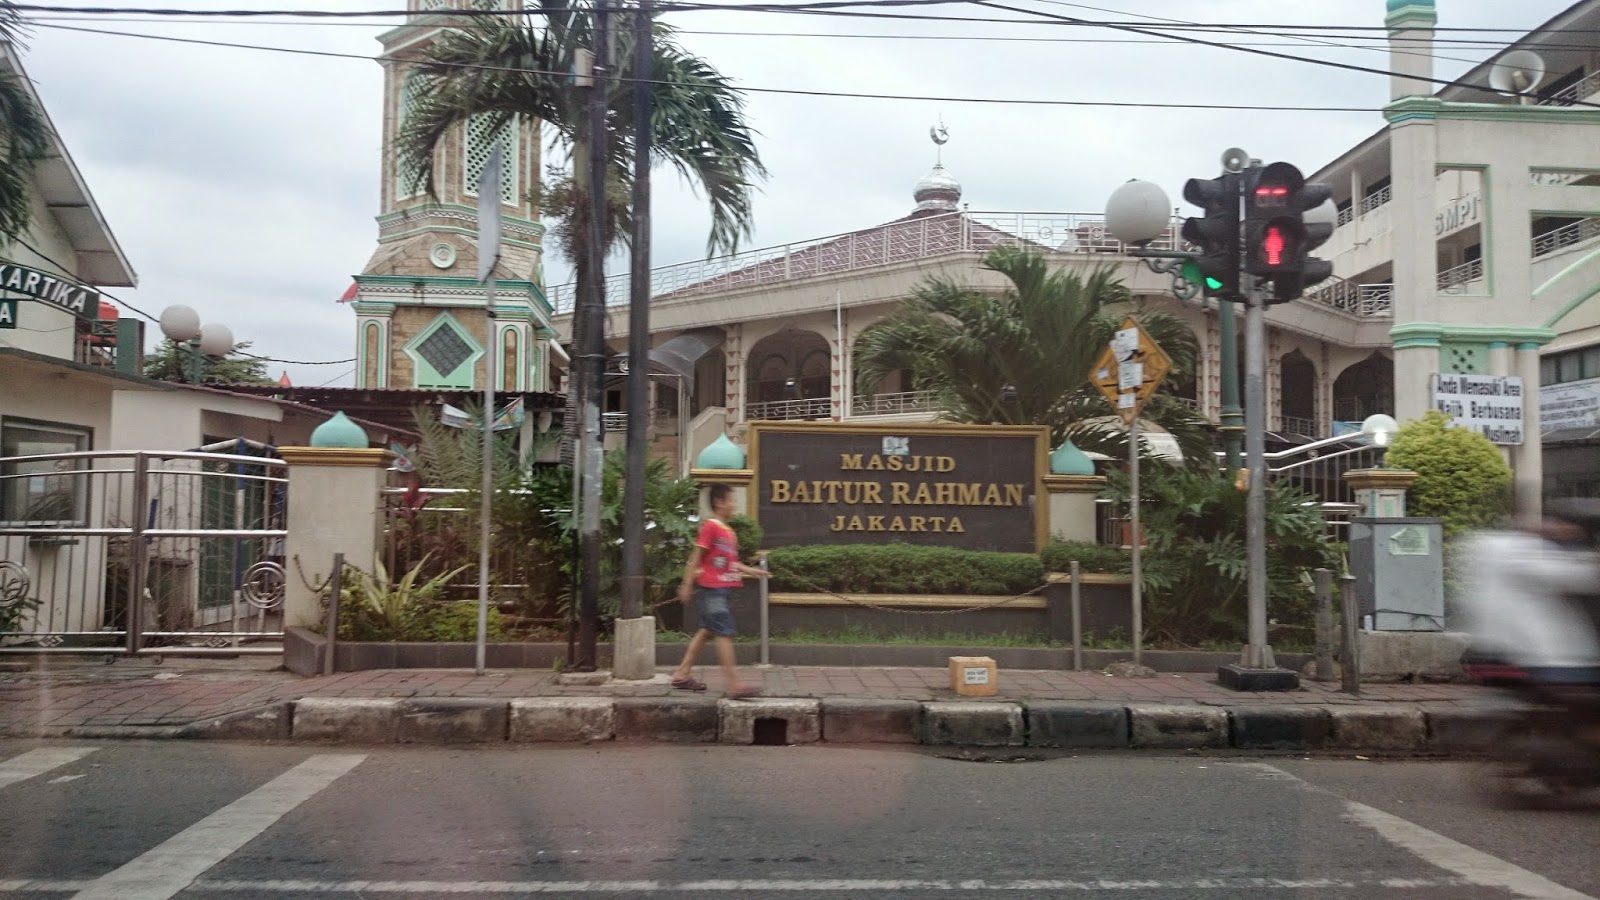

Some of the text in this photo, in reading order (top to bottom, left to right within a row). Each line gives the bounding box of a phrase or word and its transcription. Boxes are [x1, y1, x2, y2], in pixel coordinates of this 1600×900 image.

[1437, 375, 1457, 394] Anda
[1460, 377, 1500, 396] Memasuki
[1503, 381, 1520, 397] Area
[1470, 401, 1520, 420] Berbusana
[840, 453, 956, 472] MASJID
[770, 479, 1025, 506] BAITUR RAHMAN
[830, 515, 966, 533] JAKARTA
